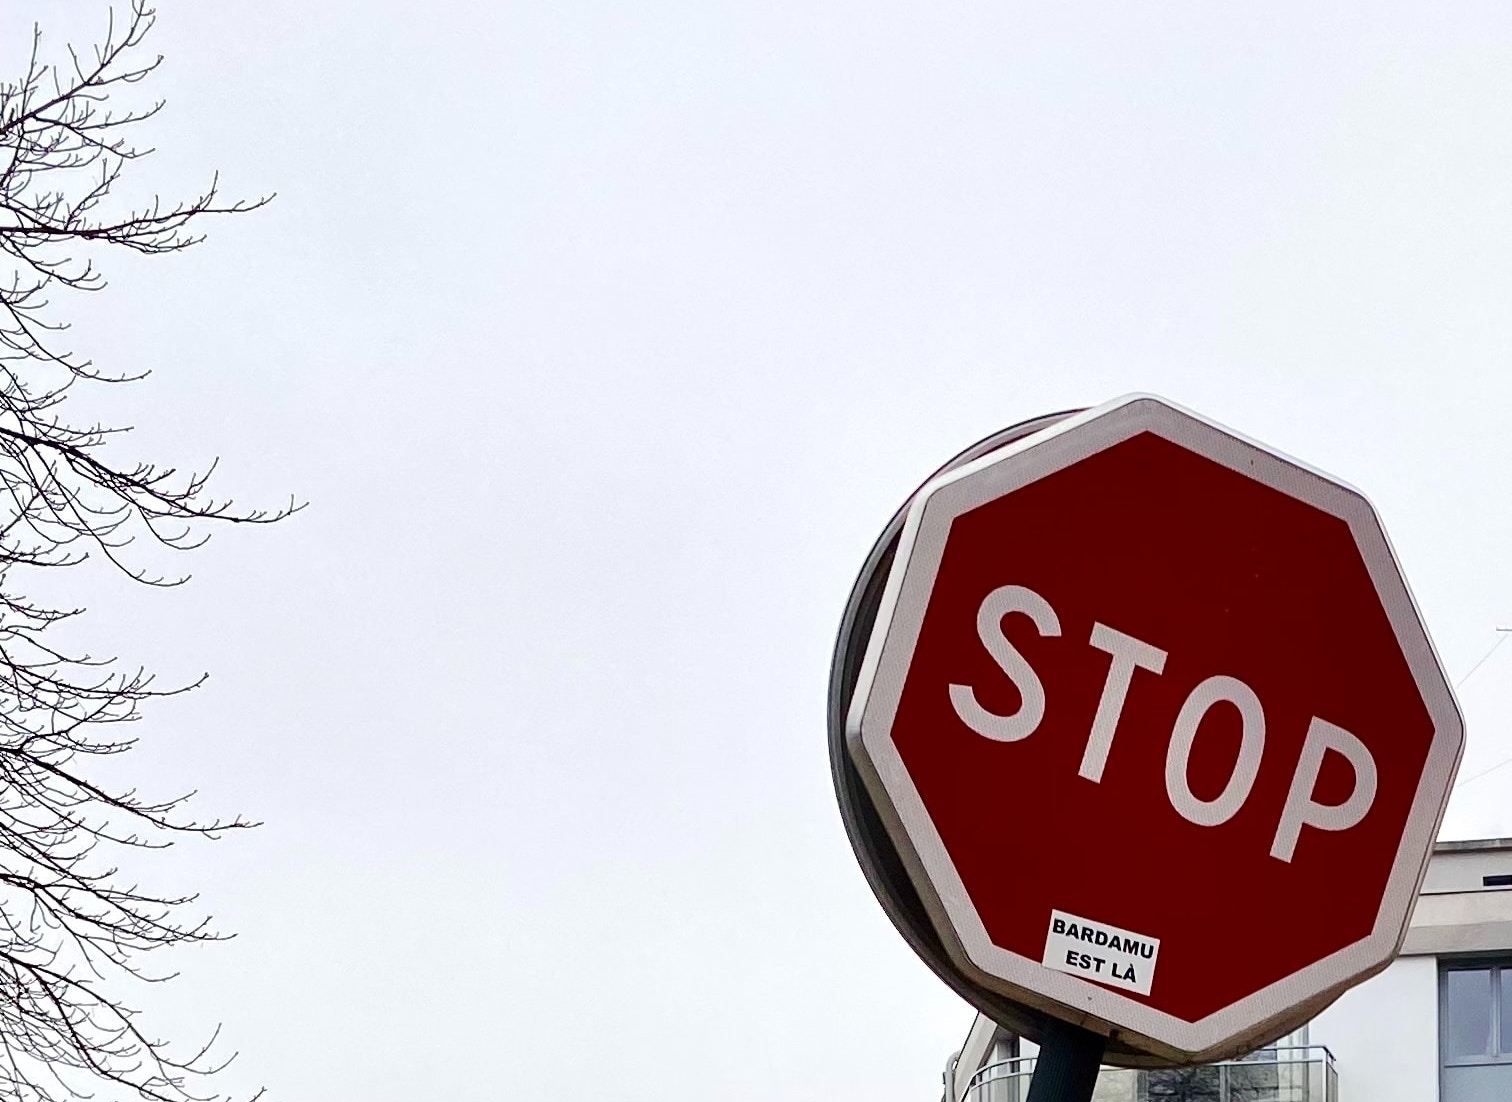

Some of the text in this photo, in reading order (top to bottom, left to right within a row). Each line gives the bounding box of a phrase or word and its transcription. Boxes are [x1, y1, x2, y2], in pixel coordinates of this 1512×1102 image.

[948, 585, 1378, 864] STOP
[1052, 918, 1154, 959] BARDAMU
[1065, 950, 1137, 984] EST LÀ
